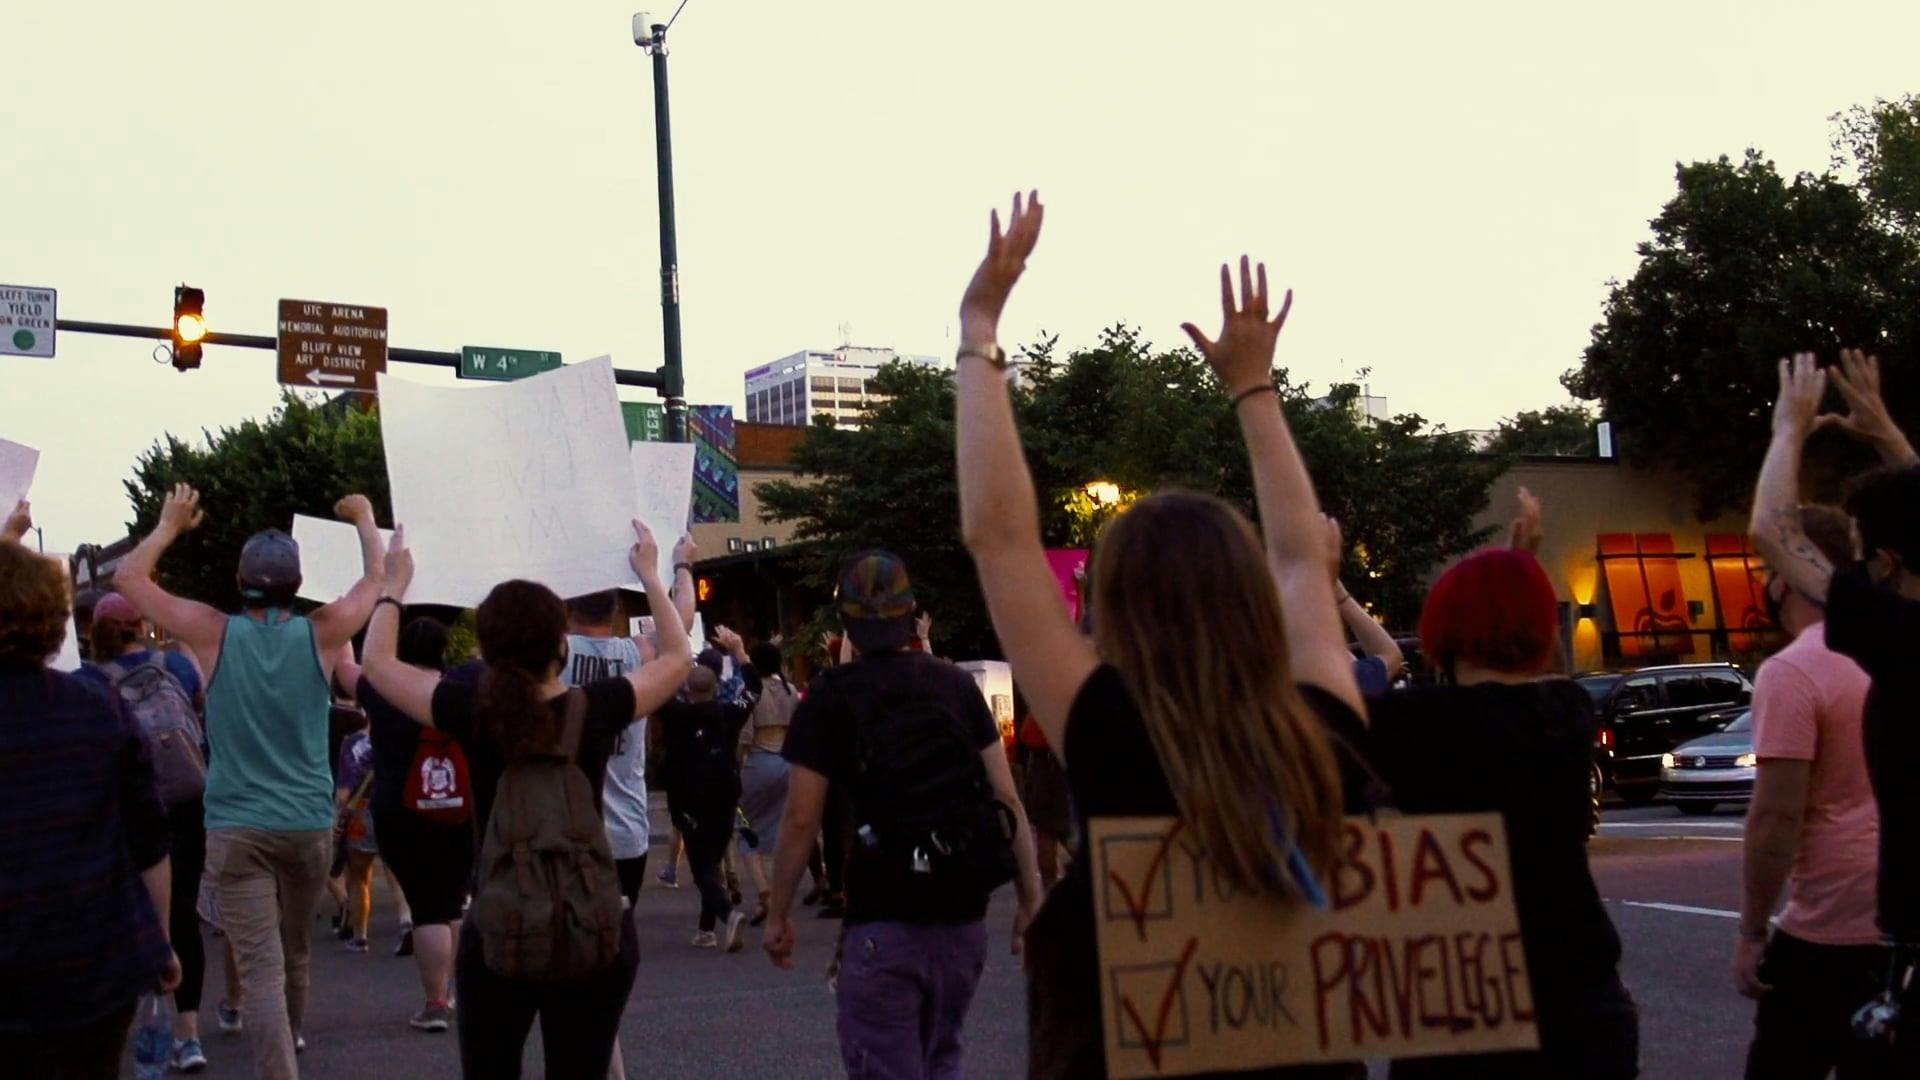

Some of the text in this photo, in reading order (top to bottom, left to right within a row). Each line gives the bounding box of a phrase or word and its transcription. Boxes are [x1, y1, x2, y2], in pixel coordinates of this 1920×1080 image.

[8, 302, 42, 316] YIELD
[303, 304, 364, 319] UTC ARENA
[18, 316, 50, 328] GREEN
[280, 321, 386, 340] MEMORIAL AUDITORIUM
[301, 341, 362, 357] BLUFF VIEW
[295, 354, 366, 370] ART DISTRICT
[472, 353, 486, 371] W
[1329, 822, 1500, 912] BIAS
[1197, 961, 1299, 1035] YOUR
